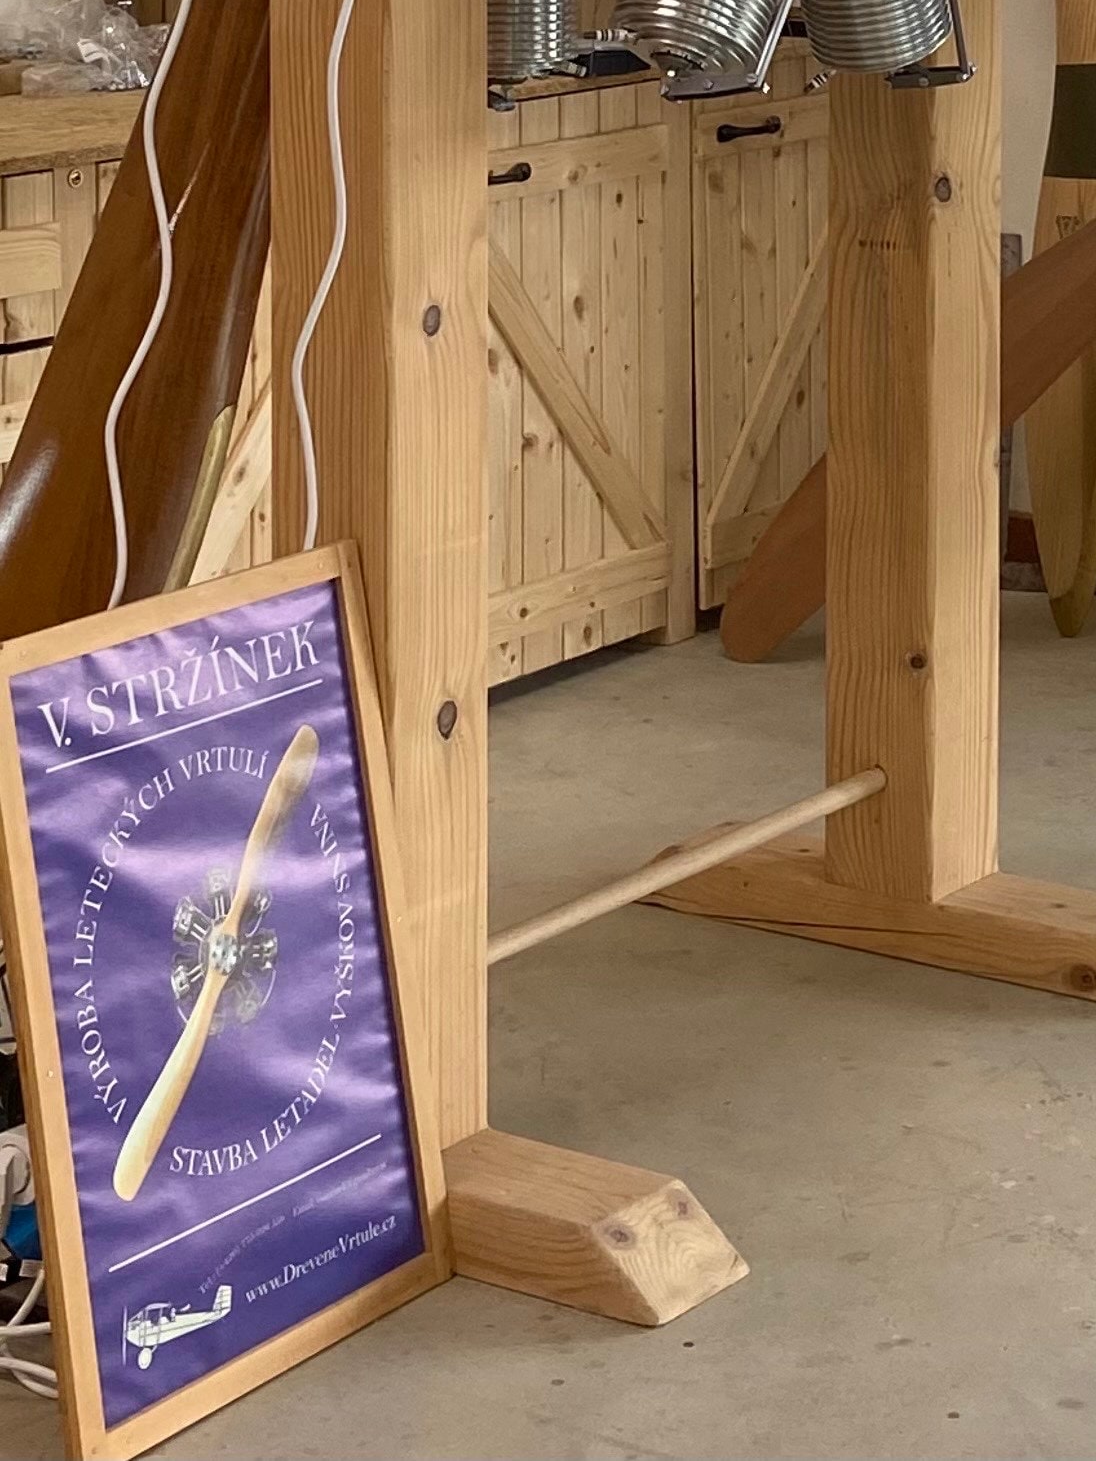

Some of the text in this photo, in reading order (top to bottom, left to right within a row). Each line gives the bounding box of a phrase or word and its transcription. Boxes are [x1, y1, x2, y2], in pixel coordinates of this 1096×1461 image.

[37, 620, 321, 748] V. STRŽÍNEK
[72, 746, 270, 1124] VÝROBA LETECKÝCH VRTULÍ
[169, 1138, 259, 1176] STAVBA
[259, 1032, 340, 1154] LETADEL
[244, 1214, 397, 1303] www.DreveneVrtule.cz
